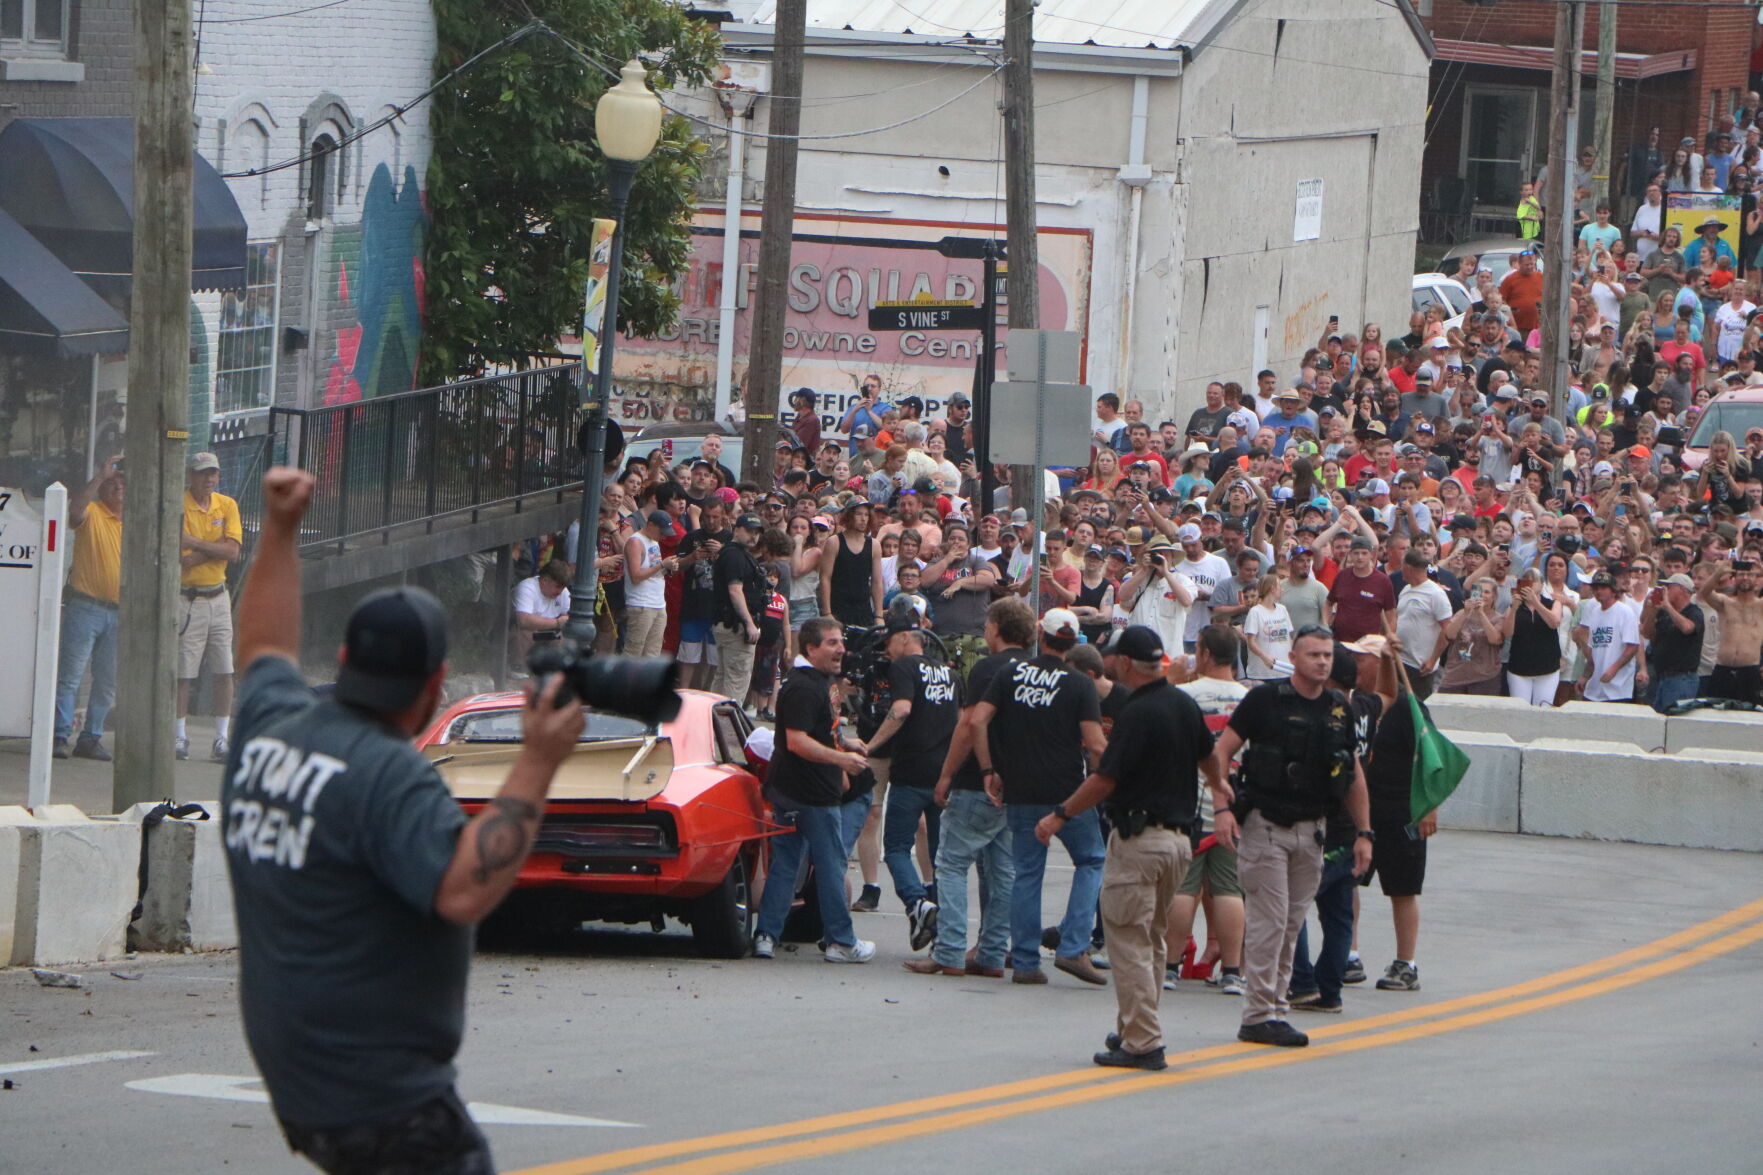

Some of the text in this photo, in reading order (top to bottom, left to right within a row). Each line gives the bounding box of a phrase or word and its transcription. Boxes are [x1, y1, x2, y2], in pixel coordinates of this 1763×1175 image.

[787, 264, 977, 318] SQUAR
[898, 311, 951, 328] S VINE ST
[782, 327, 1008, 360] owne Centr
[9, 544, 37, 560] OF
[919, 663, 951, 684] STUNT
[1013, 661, 1068, 687] STUNT
[924, 682, 955, 705] CREW
[1014, 684, 1061, 709] CREW
[232, 735, 348, 814] STUNT
[226, 798, 316, 869] CREW
